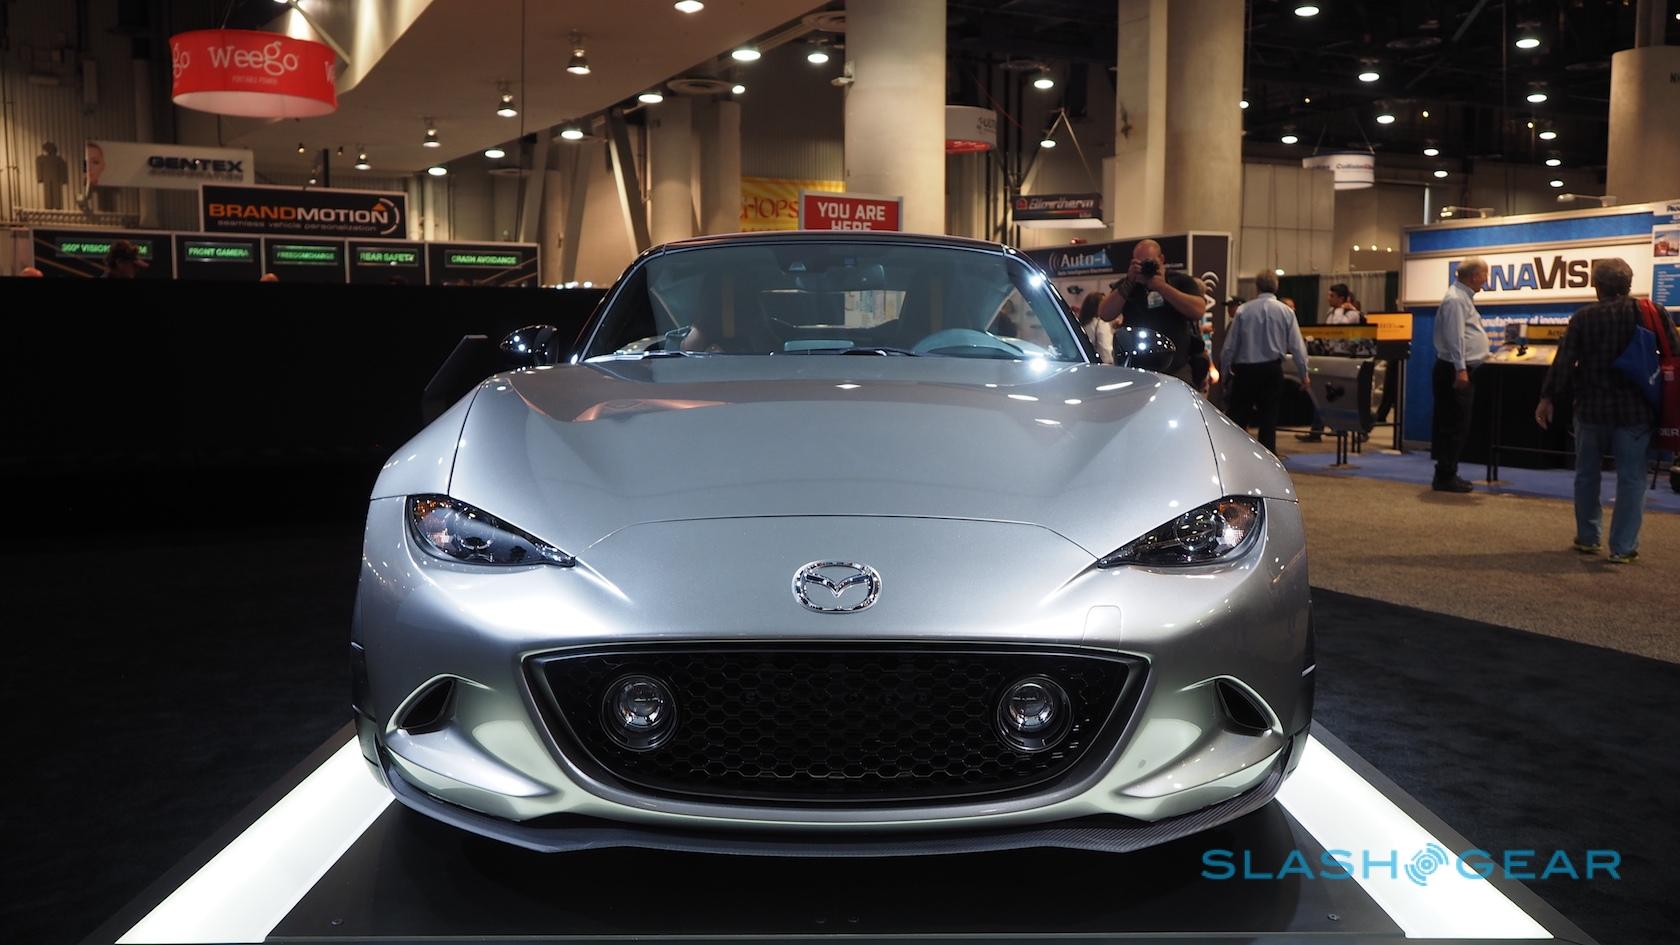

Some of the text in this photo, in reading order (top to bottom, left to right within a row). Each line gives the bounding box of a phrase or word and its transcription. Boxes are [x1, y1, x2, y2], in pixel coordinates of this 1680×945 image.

[208, 41, 298, 76] Weego
[148, 156, 243, 173] GENTEX
[208, 203, 388, 223] BRANDMOTION
[740, 197, 799, 218] HOPS
[818, 202, 885, 220] YOU ARE
[304, 223, 376, 232] personalization
[188, 247, 249, 257] FRONT CAMERA
[360, 252, 414, 262] REAR SAFETY
[451, 255, 517, 265] CRASH AVOIDANCE
[1060, 248, 1107, 268] Auto-i
